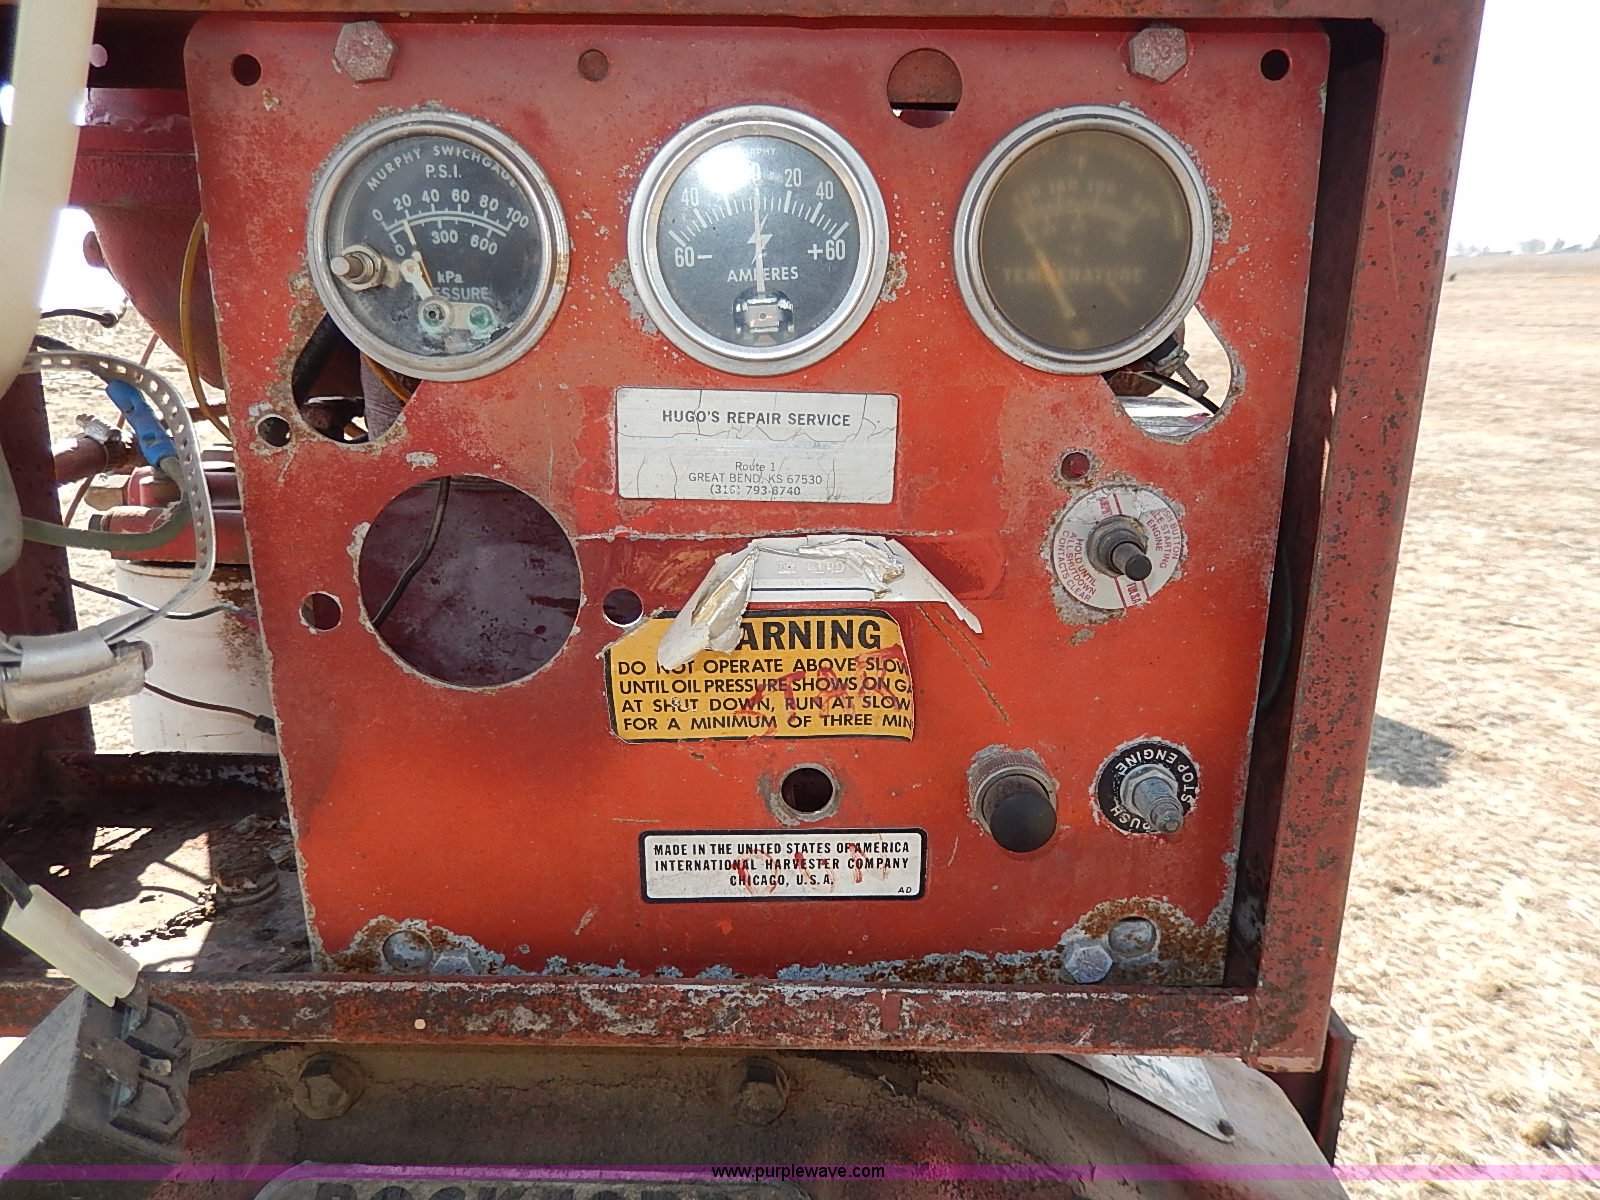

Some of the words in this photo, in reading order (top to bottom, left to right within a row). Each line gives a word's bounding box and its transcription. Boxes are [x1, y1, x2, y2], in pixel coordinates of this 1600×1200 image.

[366, 148, 421, 191] MURPHY
[425, 164, 462, 179] P.S.I.
[681, 187, 699, 207] 40
[784, 168, 802, 188] 20
[815, 181, 834, 201] 40
[372, 209, 383, 222] 0
[393, 193, 412, 212] 20
[421, 189, 440, 204] 40
[452, 189, 470, 204] 60
[479, 195, 499, 212] 80
[506, 207, 530, 229] 100
[394, 243, 406, 257] 0
[431, 230, 459, 245] 300
[470, 234, 498, 256] 600
[807, 240, 846, 261] +60
[437, 270, 463, 284] kPa
[662, 409, 720, 423] HUGO'S
[727, 411, 782, 425] REPAIR
[788, 413, 851, 427] SERVICE
[735, 461, 766, 472] Route
[770, 462, 776, 472] 1
[688, 472, 725, 483] GREAT
[768, 474, 783, 484] KS
[787, 475, 823, 485] 67530
[1066, 532, 1078, 552] ALL
[1147, 519, 1163, 552] ENGINE
[1170, 522, 1181, 560] BUTTON
[1160, 525, 1172, 569] STARTING
[1058, 530, 1071, 580] CONTACTS
[1066, 580, 1092, 602] CLEAR
[1074, 538, 1083, 564] HOLD
[1079, 564, 1097, 587] UNTIL
[1066, 553, 1096, 595] SHUTDOWN
[735, 619, 881, 651] ARNING
[618, 660, 647, 675] DO
[703, 659, 783, 674] OPERATE
[792, 657, 857, 672] ABOVE
[619, 680, 669, 695] UNTIL
[671, 680, 701, 693] OIL
[704, 679, 788, 693] PRESSURE
[792, 677, 858, 691] SHOWS
[862, 676, 890, 691] ON
[621, 699, 643, 713] AT
[653, 698, 699, 713] SHUT
[709, 697, 775, 713] DOWN,
[785, 696, 823, 711] RUN
[832, 696, 854, 709] AT
[862, 695, 910, 711] SLOW
[623, 717, 658, 731] FOR
[668, 717, 682, 731] A
[691, 716, 778, 730] MINIMUM
[787, 715, 812, 729] OF
[820, 713, 873, 727] THREE
[1115, 748, 1178, 776] ENGINE
[1177, 763, 1195, 804] STOP
[653, 844, 688, 856] MADE
[692, 843, 706, 855] IN
[709, 843, 732, 855] THE
[737, 843, 781, 855] UNITED
[786, 842, 831, 854] STATES
[836, 842, 851, 854] OF
[854, 841, 910, 853] AMERICA
[655, 859, 757, 871] INTERNATIONAL
[765, 858, 840, 870] HARVESTER
[847, 857, 909, 869] COMPANY
[729, 874, 789, 887] CHICAGO,
